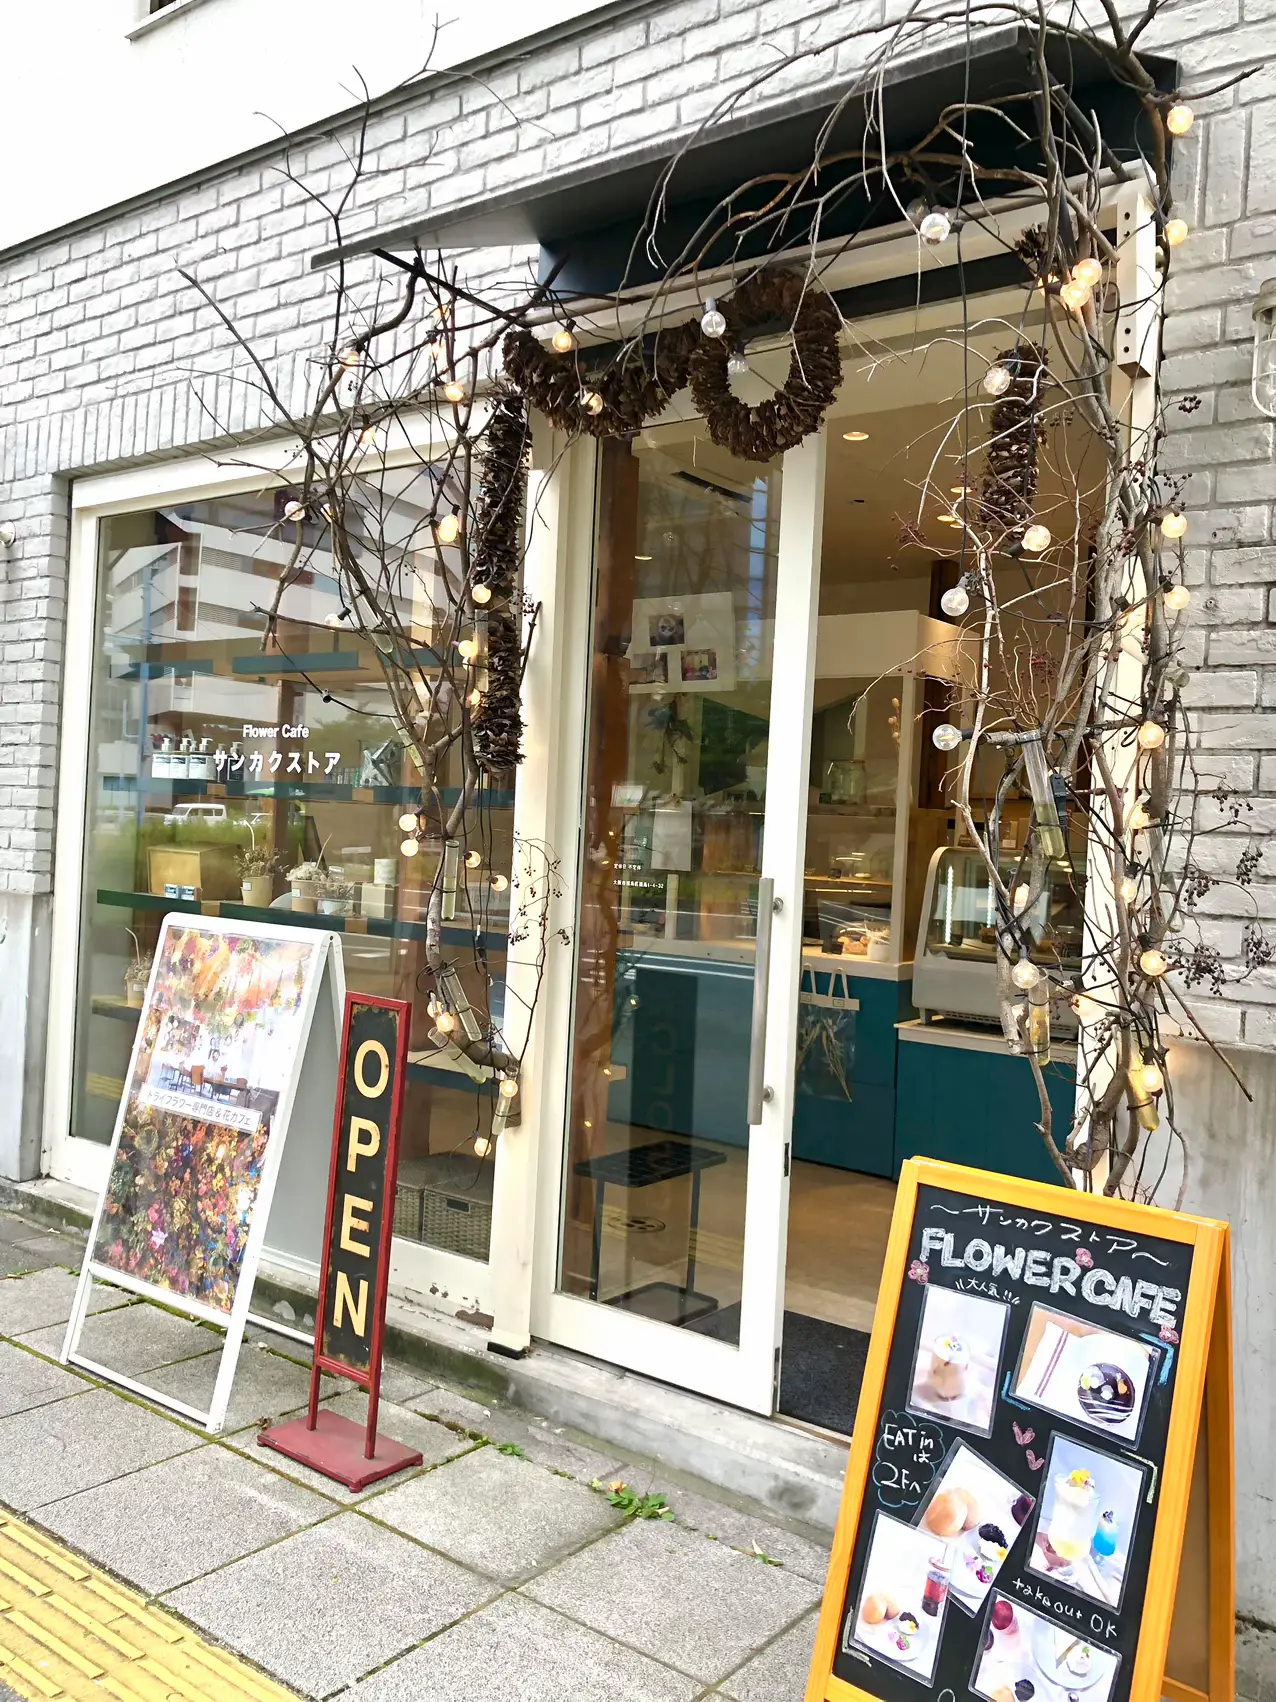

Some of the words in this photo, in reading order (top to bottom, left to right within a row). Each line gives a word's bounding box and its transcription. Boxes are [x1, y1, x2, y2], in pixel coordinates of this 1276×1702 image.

[242, 724, 280, 738] Flower
[281, 724, 310, 738] Cafe
[213, 750, 341, 775] サンカクストア
[332, 1039, 390, 1338] OPEN
[920, 1227, 1081, 1297] FLOWER
[1080, 1268, 1182, 1329] CAFE
[883, 1423, 917, 1450] EAT
[919, 1431, 934, 1449] in
[913, 1449, 931, 1463] は
[1090, 1613, 1118, 1639] OK
